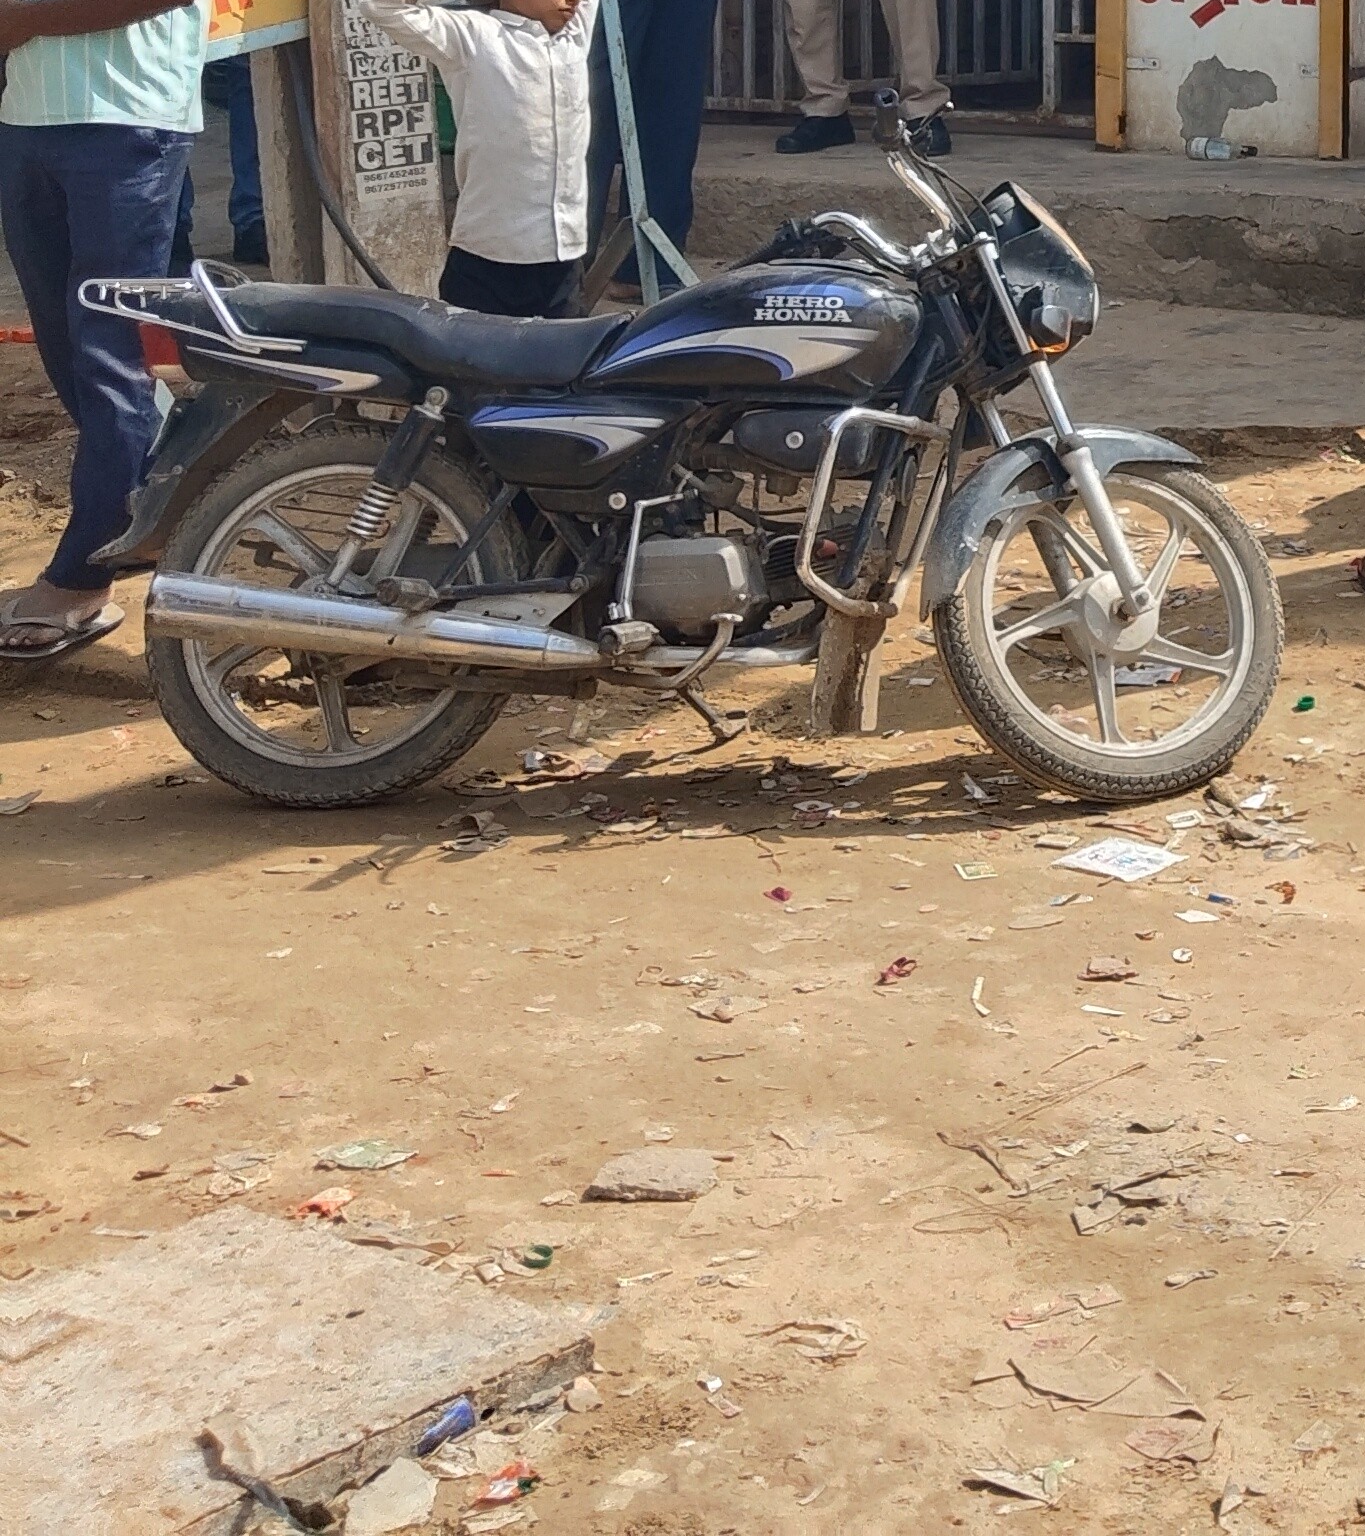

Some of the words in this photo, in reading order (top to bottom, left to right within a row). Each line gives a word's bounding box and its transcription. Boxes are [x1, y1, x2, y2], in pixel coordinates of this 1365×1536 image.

[352, 74, 425, 110] REET
[355, 104, 426, 140] RPF
[356, 135, 429, 171] CET
[753, 307, 852, 323] HONDA
[764, 294, 845, 309] HERO
